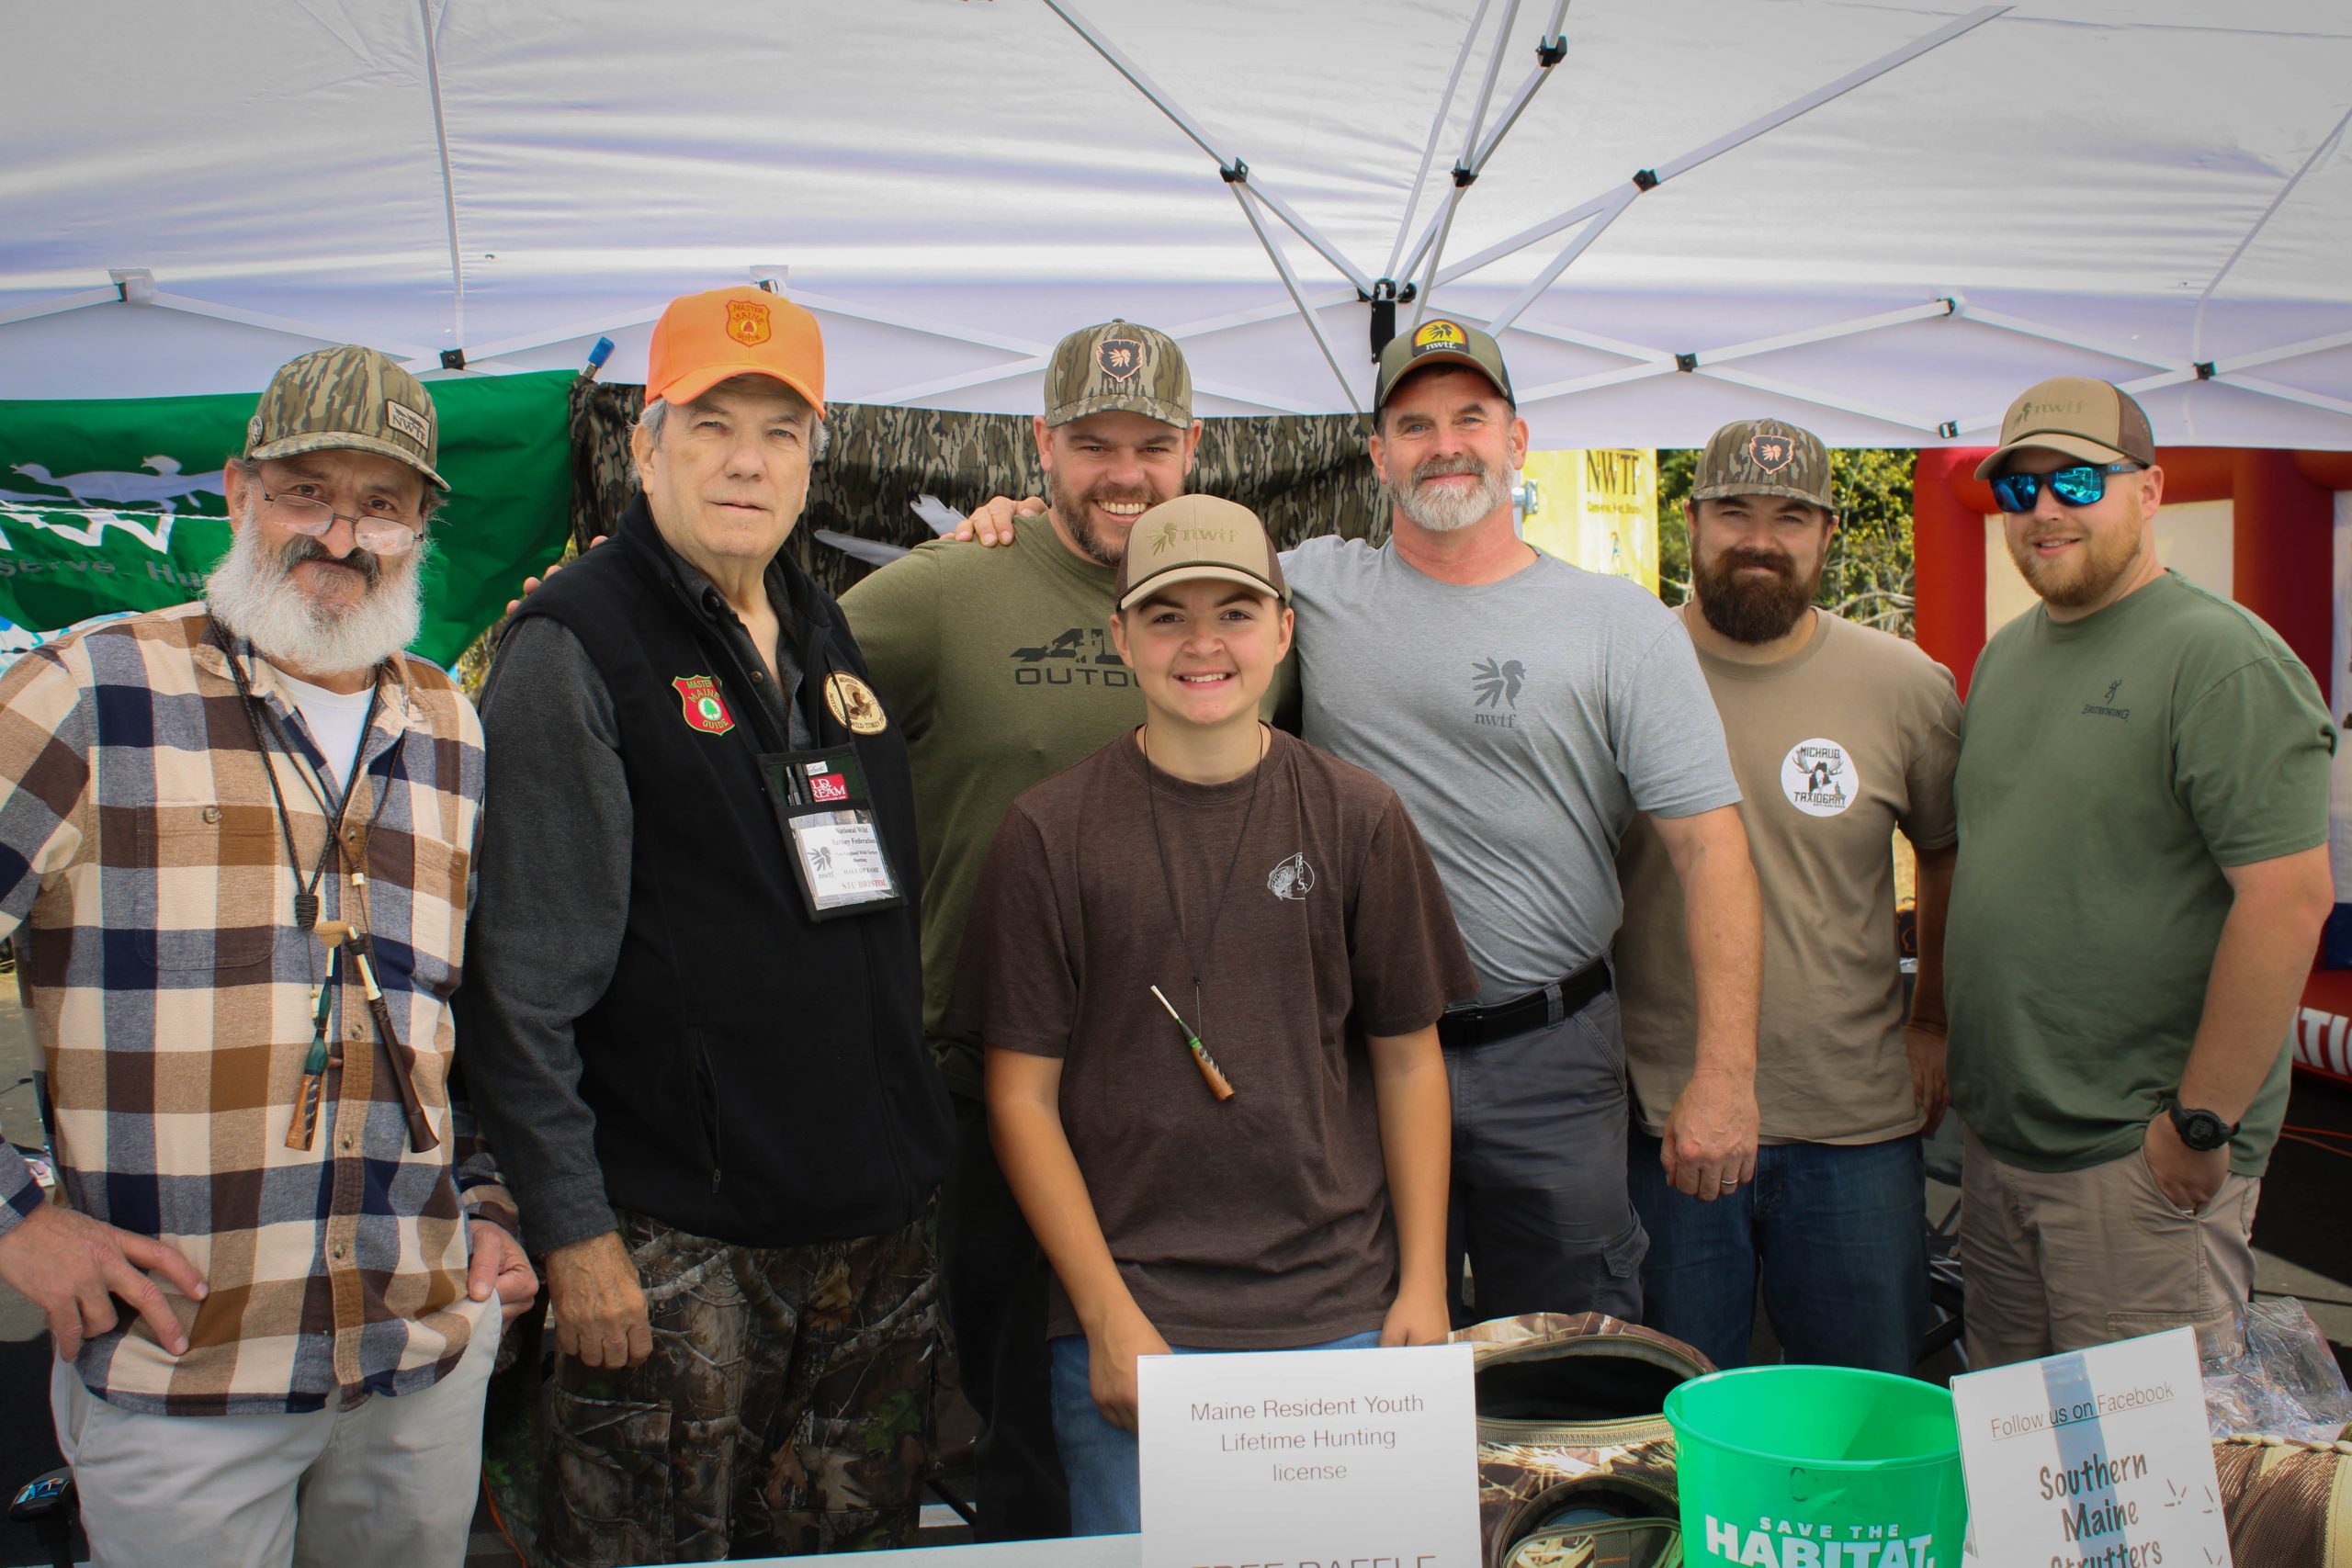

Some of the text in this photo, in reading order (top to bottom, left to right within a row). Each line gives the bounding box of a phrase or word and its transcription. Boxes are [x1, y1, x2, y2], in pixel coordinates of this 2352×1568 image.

[392, 414, 426, 441] NWTF
[686, 679, 714, 690] MASTER
[687, 688, 721, 704] MAINE
[702, 718, 729, 729] GUIDE
[1474, 712, 1517, 728] nwtf
[1800, 746, 1840, 760] MICHAUD
[1191, 1393, 1424, 1422] Maine Resident Youth
[1990, 1381, 2175, 1439] Follow us on Facebook
[1221, 1427, 1396, 1452] Lifetime Hunting
[1272, 1463, 1348, 1482] license
[2039, 1452, 2148, 1501] Southern
[1758, 1516, 1899, 1540] SAVE THE
[2061, 1498, 2140, 1542] Maine
